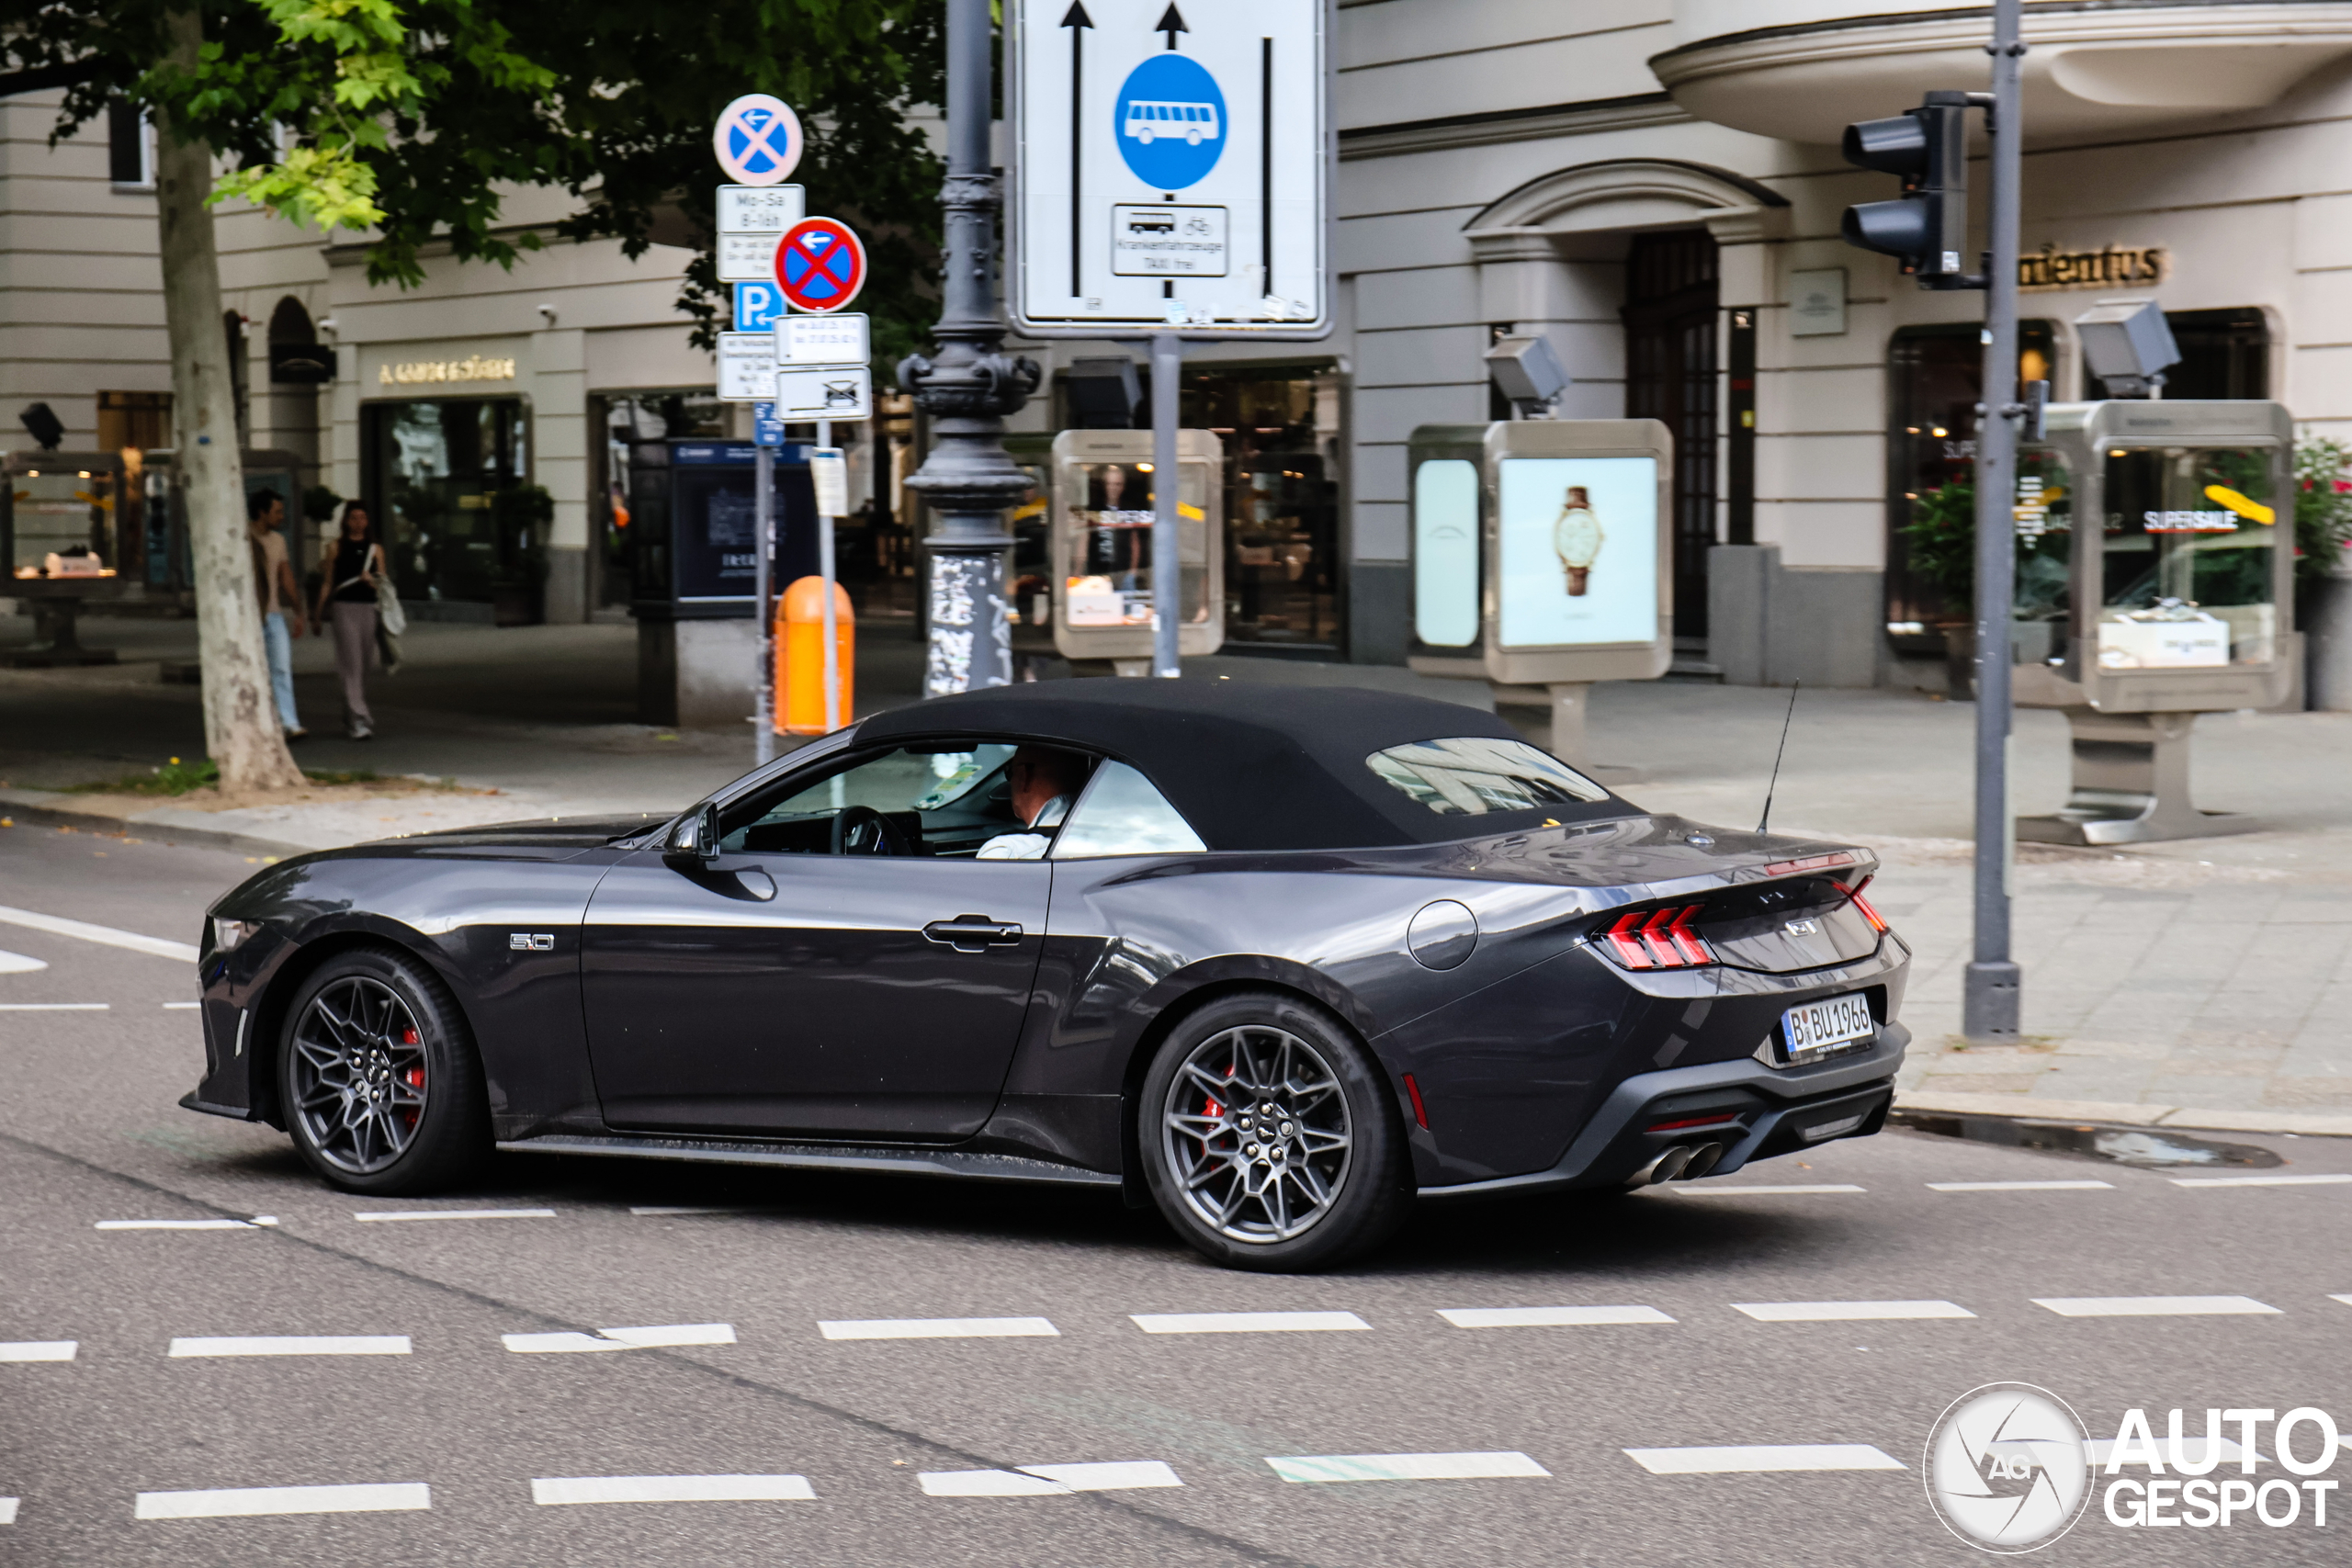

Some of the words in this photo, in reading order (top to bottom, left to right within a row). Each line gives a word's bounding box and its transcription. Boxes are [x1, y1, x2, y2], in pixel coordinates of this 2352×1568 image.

[1115, 238, 1224, 254] Krankenfahrzeuge
[1784, 917, 1818, 937] GT
[510, 933, 555, 951] 5.0
[1791, 1012, 1804, 1045] B
[1811, 1006, 1833, 1042] BU
[1833, 998, 1870, 1036] 1966
